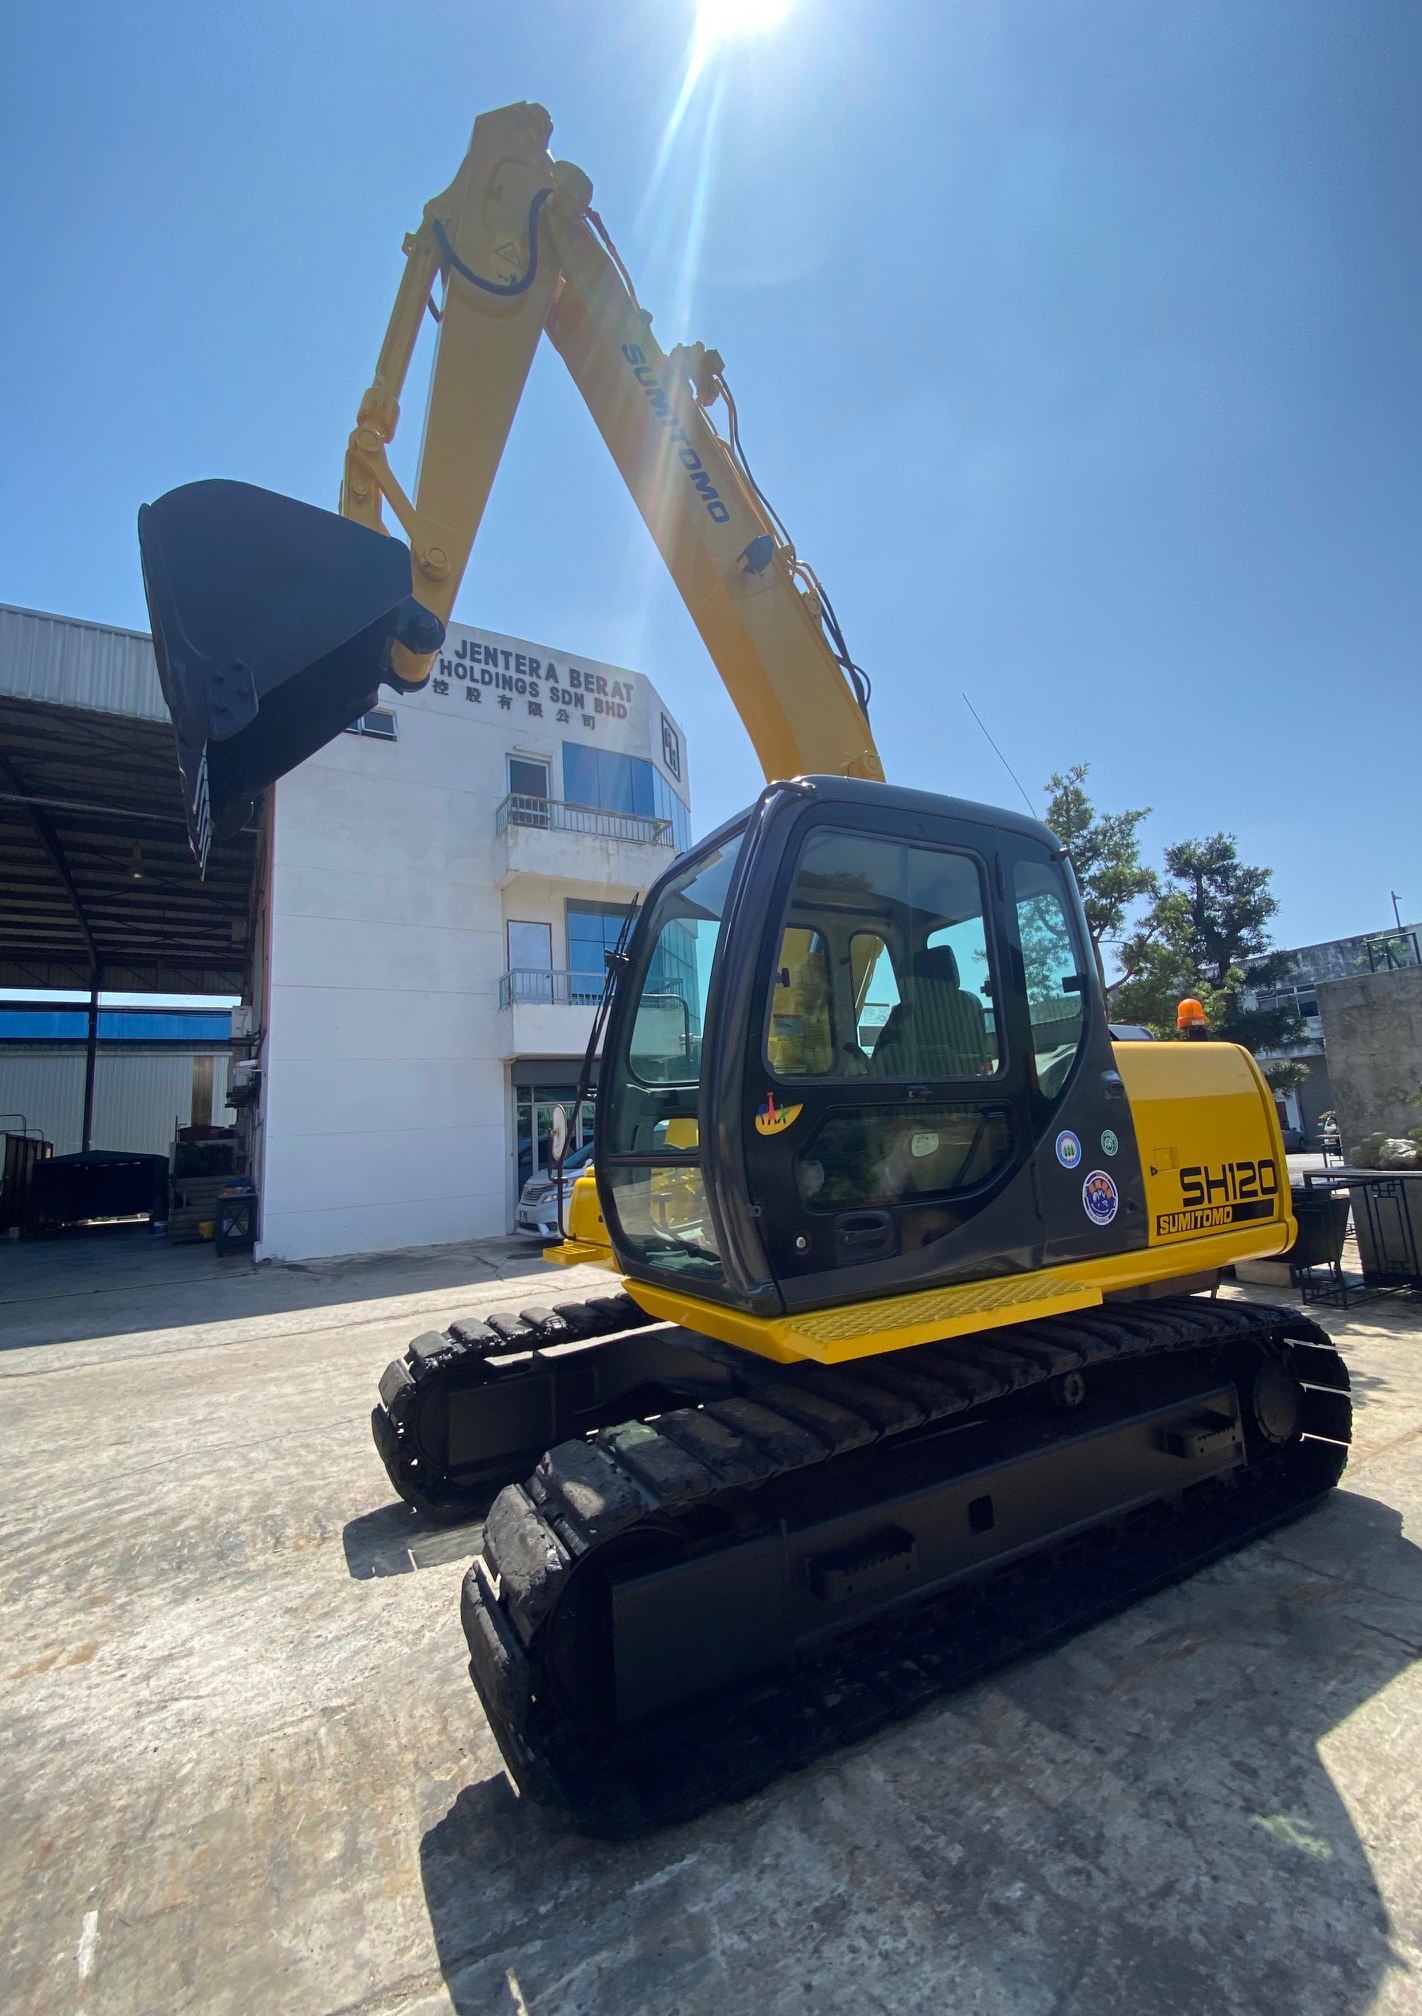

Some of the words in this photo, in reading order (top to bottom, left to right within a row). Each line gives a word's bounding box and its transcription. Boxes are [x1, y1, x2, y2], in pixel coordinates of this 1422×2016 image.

[621, 343, 730, 524] SUMITOMO
[440, 658, 540, 698] HOLDINGS
[549, 686, 585, 709] SDN
[594, 700, 628, 720] BHD
[454, 639, 559, 684] JENTERA
[569, 668, 634, 702] BERAT
[431, 677, 596, 730] 控股有限公司
[1179, 1158, 1278, 1208] SH120
[1159, 1205, 1233, 1235] SUMITOMO
